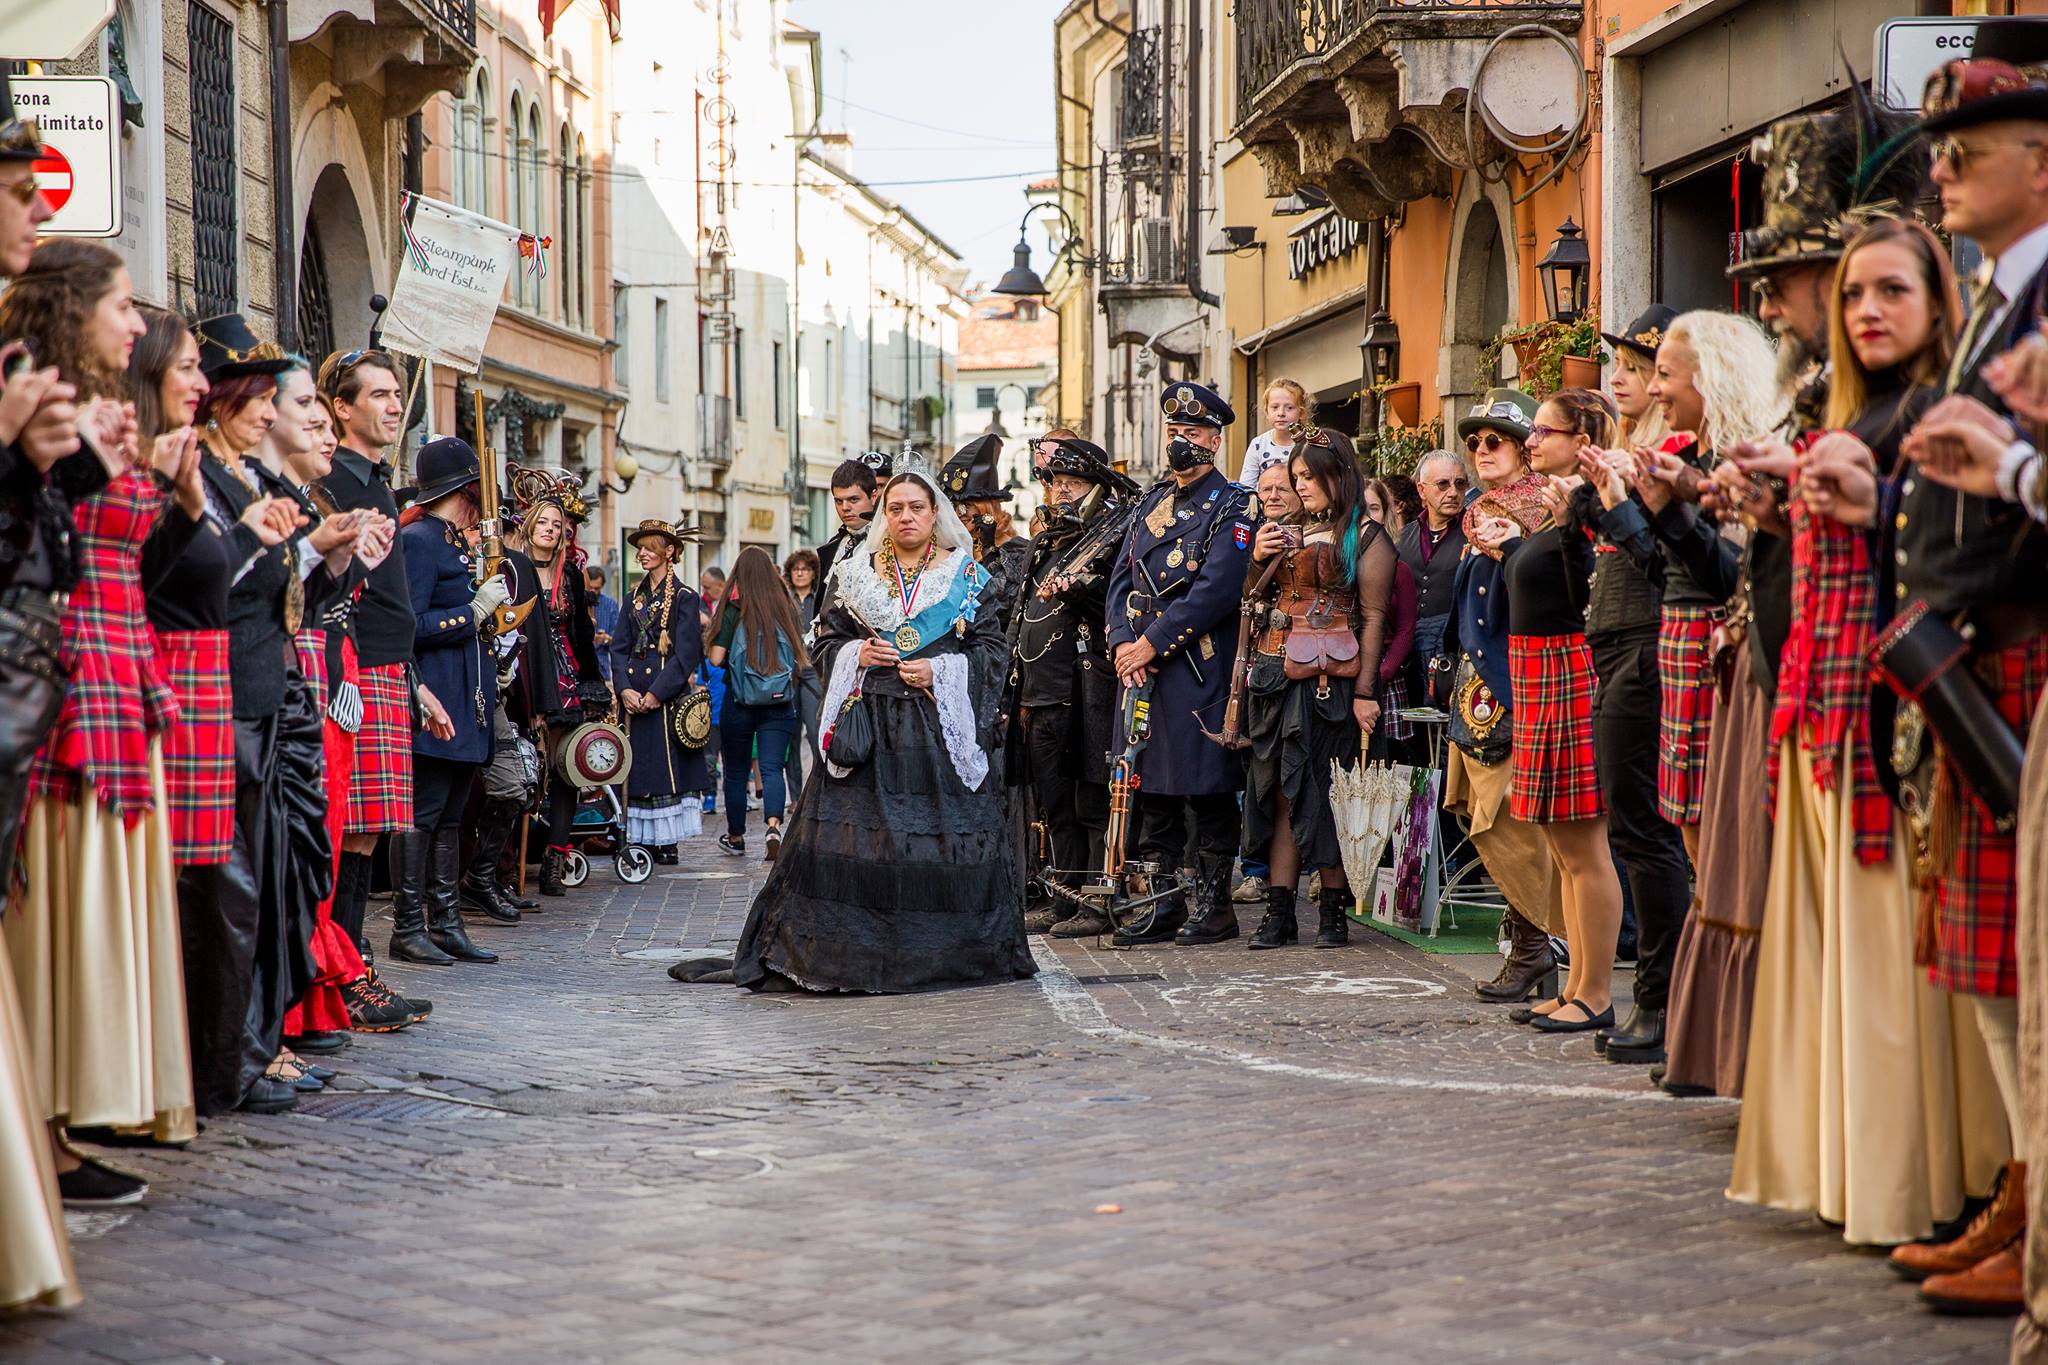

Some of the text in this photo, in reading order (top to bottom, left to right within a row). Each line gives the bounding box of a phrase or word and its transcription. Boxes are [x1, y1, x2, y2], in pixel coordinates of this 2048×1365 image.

[13, 93, 51, 106] zona
[36, 114, 104, 131] limitato
[420, 235, 496, 274] Steampunk
[413, 264, 473, 290] ord-Est
